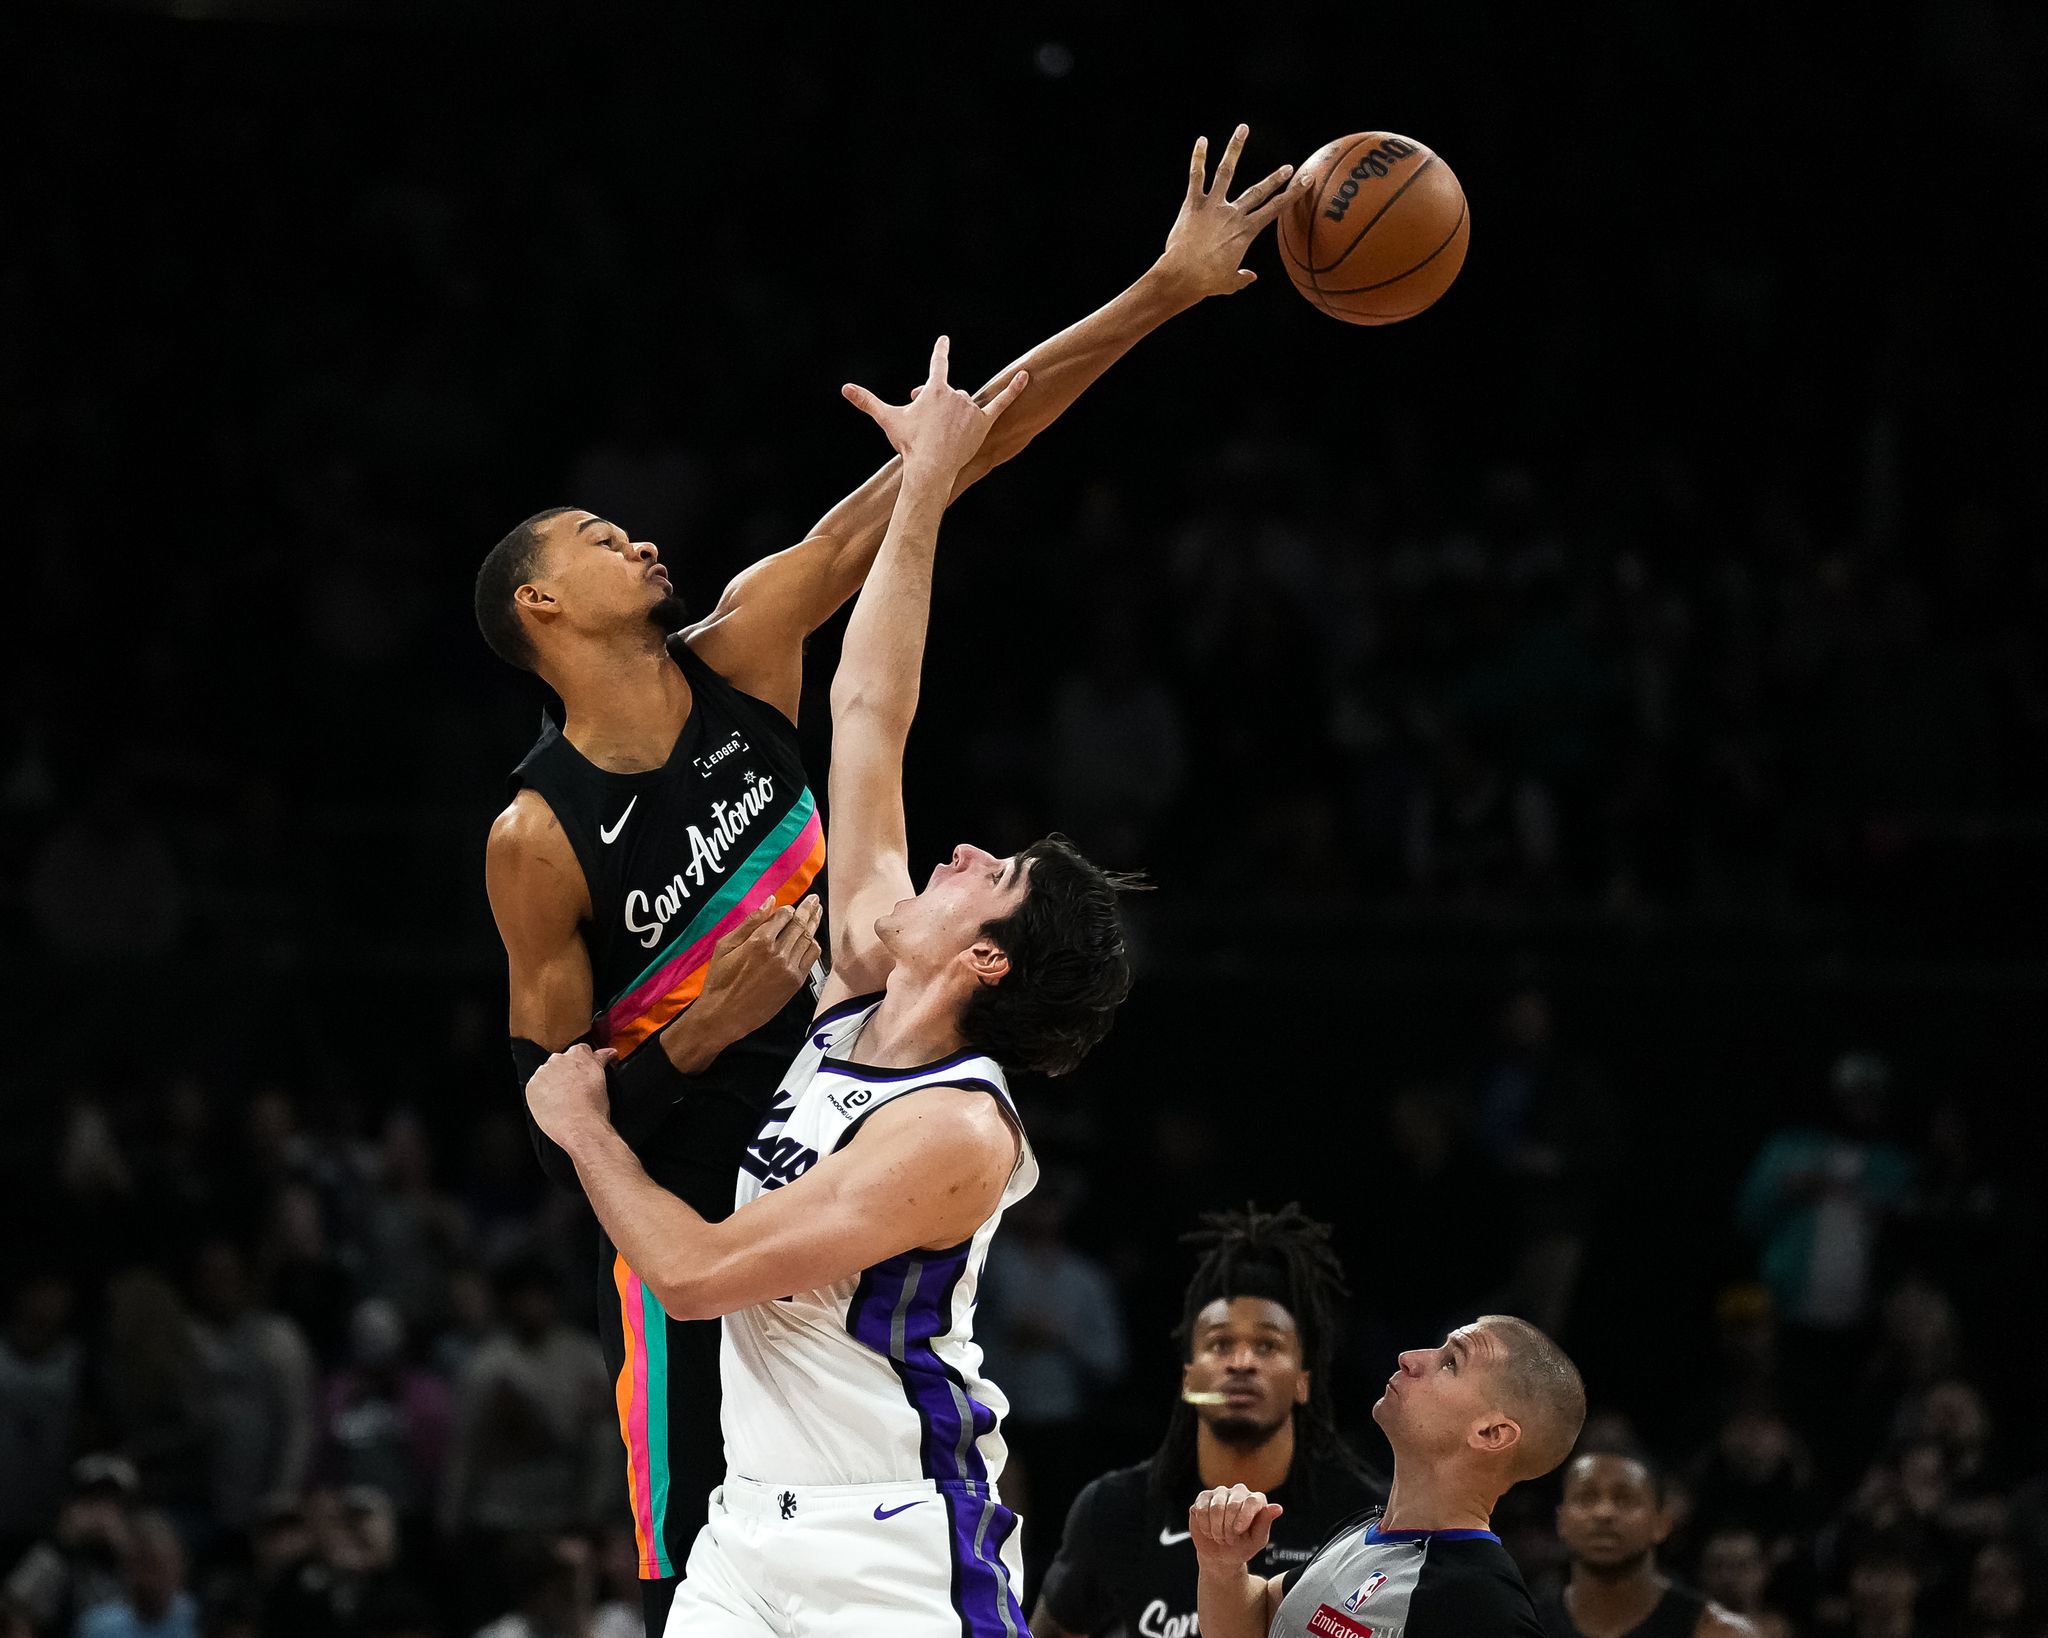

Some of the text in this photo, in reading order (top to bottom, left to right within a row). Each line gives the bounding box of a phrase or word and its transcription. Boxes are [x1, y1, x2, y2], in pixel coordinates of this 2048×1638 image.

[1326, 138, 1418, 223] Wilson
[703, 739, 741, 769] LEDGER
[624, 770, 773, 949] San Antonio
[1311, 1609, 1366, 1638] Emirate
